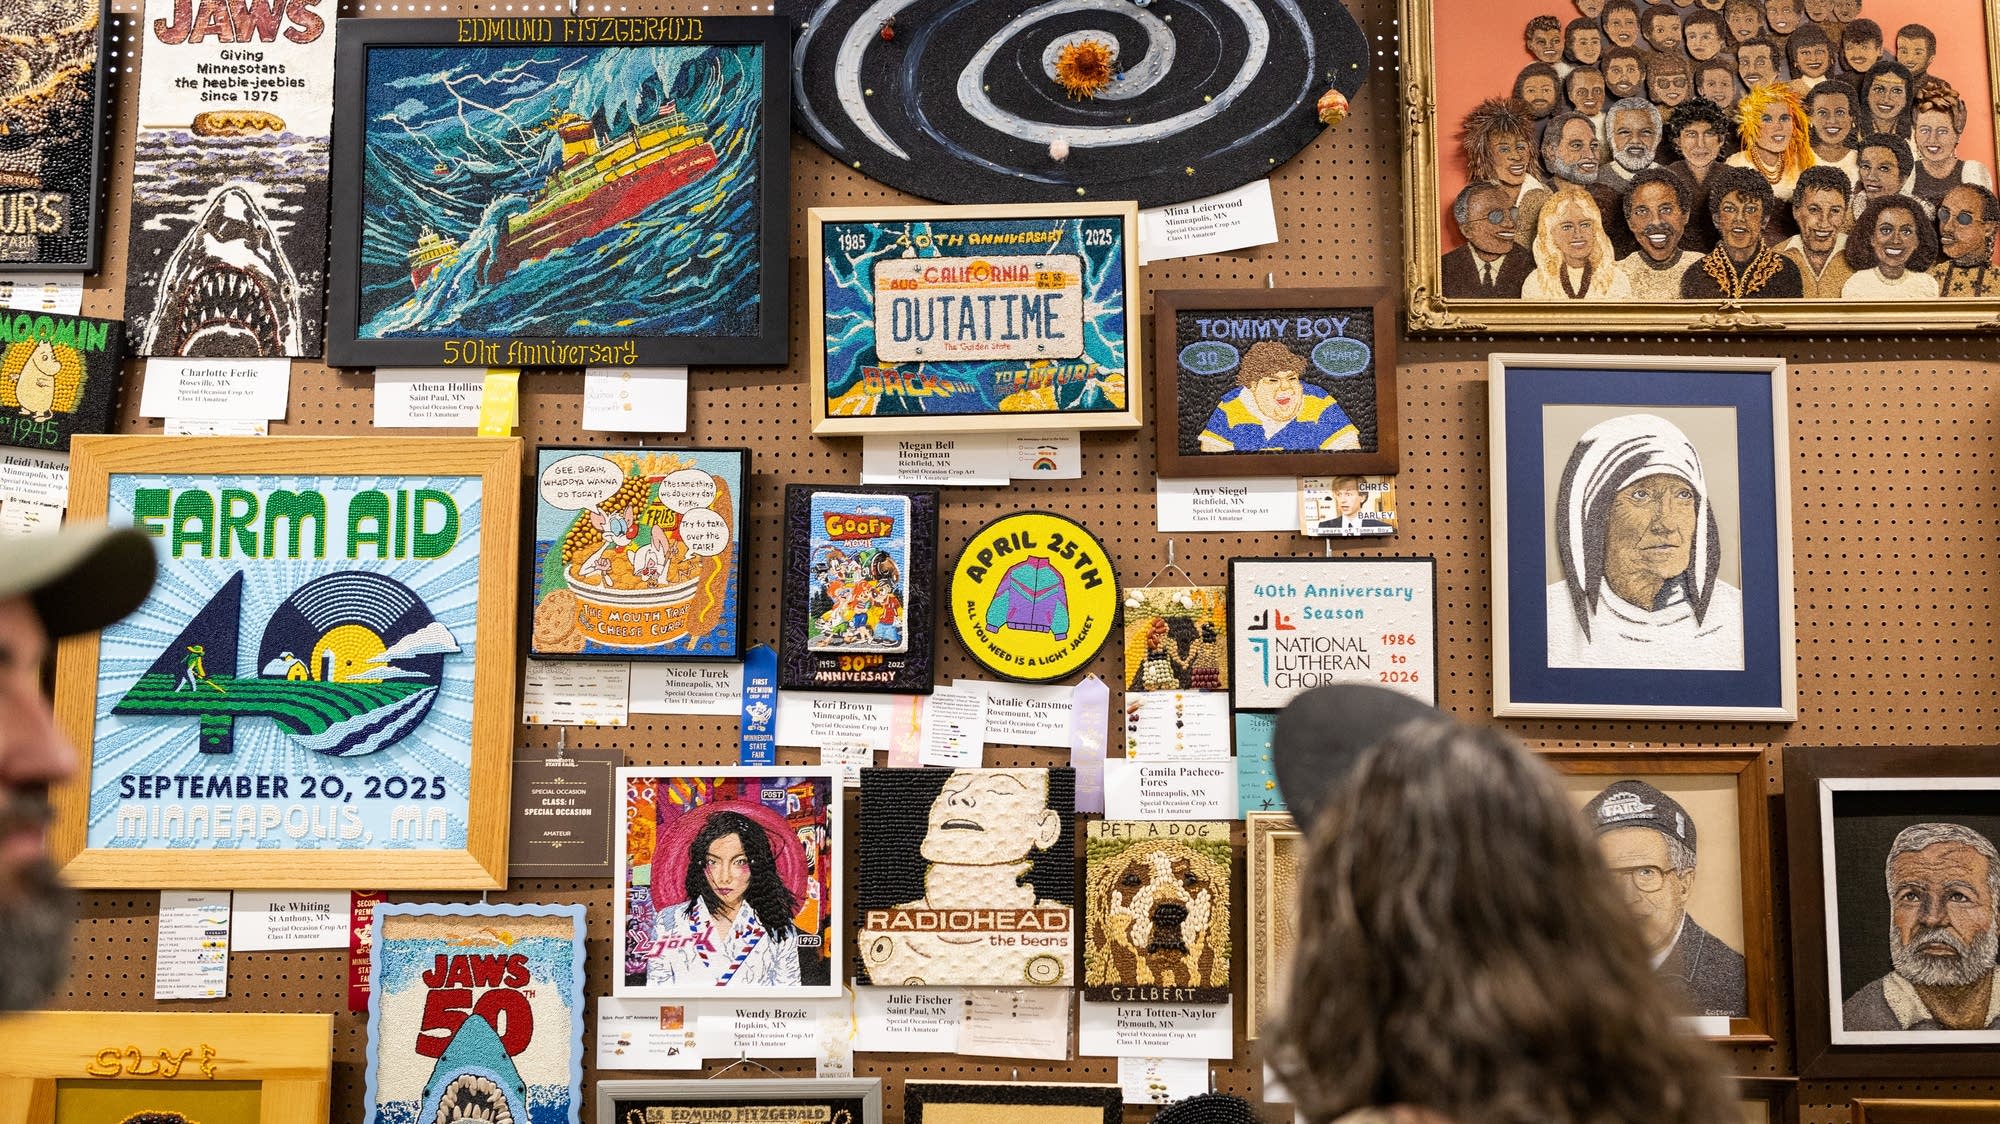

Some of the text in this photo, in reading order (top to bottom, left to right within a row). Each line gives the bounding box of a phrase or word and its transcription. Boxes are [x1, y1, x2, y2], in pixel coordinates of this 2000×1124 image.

[154, 0, 325, 45] JAWS
[457, 17, 703, 42] EDMUND FITZGERALD
[220, 50, 264, 62] Giving
[197, 63, 286, 74] Minnesotans
[175, 77, 305, 89] the heebie-jeebies
[200, 91, 279, 101] since 1975
[1164, 199, 1243, 217] Mina Leierwood
[838, 230, 1112, 250] 1985 40TH ANNIVERSARY 2025
[923, 264, 1029, 284] CALIFORNIA
[890, 279, 918, 290] AUG
[892, 294, 1065, 342] OUTATIME
[1196, 317, 1349, 339] TOMMY BOY
[443, 340, 639, 365] 50ht Anniversary
[944, 342, 1011, 351] The Golden State
[1196, 352, 1218, 365] 30
[1322, 350, 1359, 361] YEARS
[181, 368, 259, 378] Charlotte Ferlic
[862, 366, 953, 397] BACK
[1014, 363, 1101, 392] FUTURE
[409, 383, 483, 392] Athena Hollins
[13, 419, 59, 445] 1945
[899, 441, 955, 451] Megan Bell
[899, 450, 950, 460] Honigman
[5, 456, 69, 472] Heidi Makela
[555, 466, 606, 474] GEE, BRAIN,
[1192, 486, 1248, 497] Amy Siegel
[1359, 483, 1388, 491] CHRIS
[572, 490, 602, 498] TODAY?
[646, 509, 675, 525] FRIES
[133, 488, 327, 560] FARM
[346, 488, 461, 560] AID
[825, 515, 892, 537] GOOFY
[706, 532, 720, 540] the
[692, 543, 714, 551] FAIR!
[843, 540, 873, 548] MOVIE
[966, 531, 1103, 590] APRIL 25TH
[1254, 584, 1413, 601] 40th Anniversary
[583, 603, 691, 622] THE MOUTH TRAP
[1303, 606, 1364, 620] Season
[597, 622, 643, 637] CHEESE
[967, 600, 1095, 666] ALL YOU NEED IS A LIGHT JACKET
[1275, 636, 1367, 653] NATIONAL
[1381, 634, 1416, 645] 1986
[111, 569, 446, 758] 40
[819, 655, 905, 672] 1995 30TH 2025
[1275, 655, 1370, 671] LUTHERAN
[1391, 653, 1406, 664] to
[666, 668, 729, 679] Nicole Turek
[814, 671, 896, 682] ANNIVERSARY
[1379, 671, 1419, 683] 2026
[665, 680, 713, 689] Minneapolis,
[752, 678, 768, 686] FIRST
[1275, 672, 1333, 688] CHOIR
[746, 686, 773, 694] PREMIUM
[813, 700, 872, 711] Kori Brown
[988, 696, 1023, 707] Natalie
[1140, 767, 1225, 777] Camila Pacheco-
[1140, 777, 1168, 787] Fores
[120, 775, 446, 803] SEPTEMBER 20, 2025
[763, 790, 784, 799] POST
[1140, 789, 1206, 798] Minneapolis, MN
[542, 798, 567, 806] CLASS:
[524, 808, 592, 816] SPECIAL OCCASION
[116, 804, 447, 843] MINNEAPOLIS, MN
[1101, 823, 1210, 837] PET A DOG
[269, 902, 330, 914] Ike Whiting
[867, 910, 1067, 930] RADIOHEAD
[799, 936, 819, 945] 1995
[989, 934, 1068, 947] the beans
[422, 953, 531, 989] JAWS
[886, 994, 953, 1005] Julie Fischer
[1111, 988, 1196, 1001] GILBERT
[735, 1009, 807, 1020] Wendy Brozic
[886, 1007, 947, 1016] Saint Paul, MN
[1117, 1007, 1217, 1020] Lyra Totten-Naylor
[1117, 1019, 1175, 1029] Plymouth, MN
[87, 1045, 193, 1078] SLY
[670, 1106, 732, 1120] EDMUND
[735, 1106, 825, 1120] FITZGERALD
